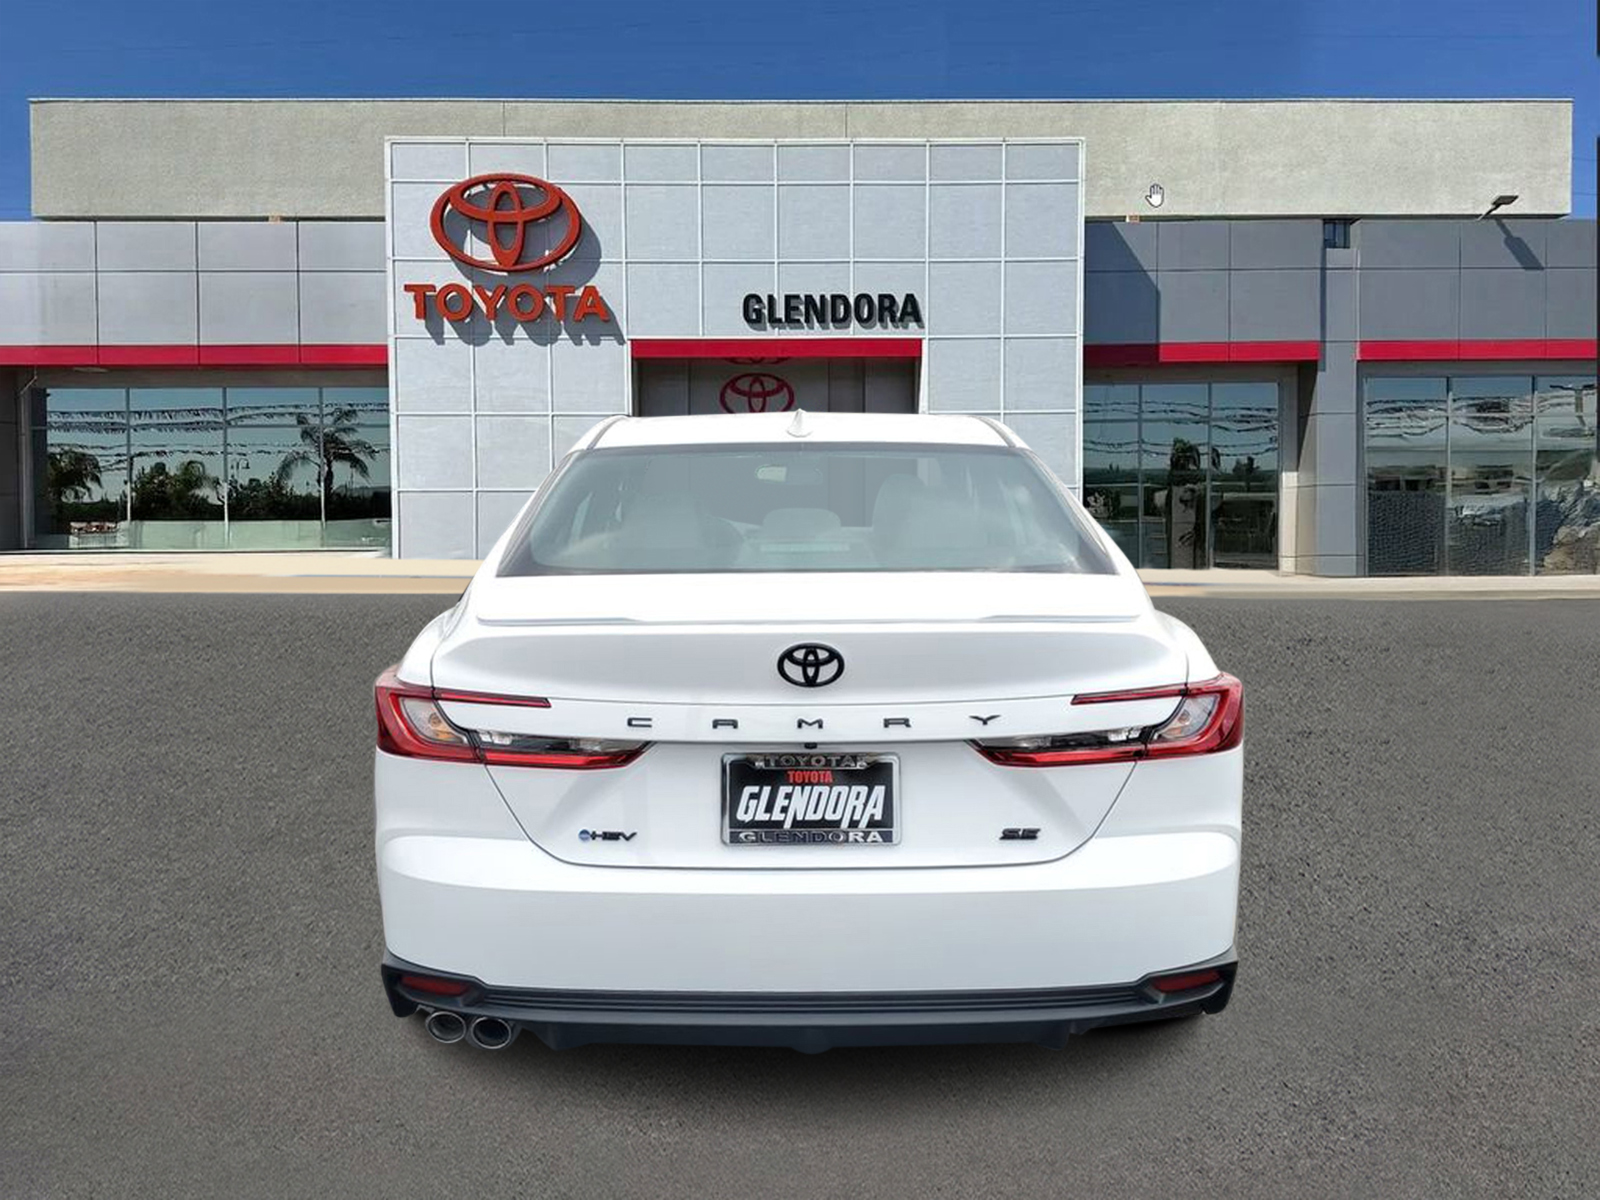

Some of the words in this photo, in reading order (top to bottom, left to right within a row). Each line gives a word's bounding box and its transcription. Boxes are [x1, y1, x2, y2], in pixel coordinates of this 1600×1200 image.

[404, 283, 611, 322] TOYOTA
[743, 293, 922, 324] GLENDORA
[626, 715, 1001, 729] CAMRY
[766, 755, 856, 767] TOYOTA
[787, 770, 833, 783] TOYOTA
[736, 785, 886, 829] GLENDORA
[739, 831, 883, 843] GLENDORA
[999, 828, 1041, 840] SE
